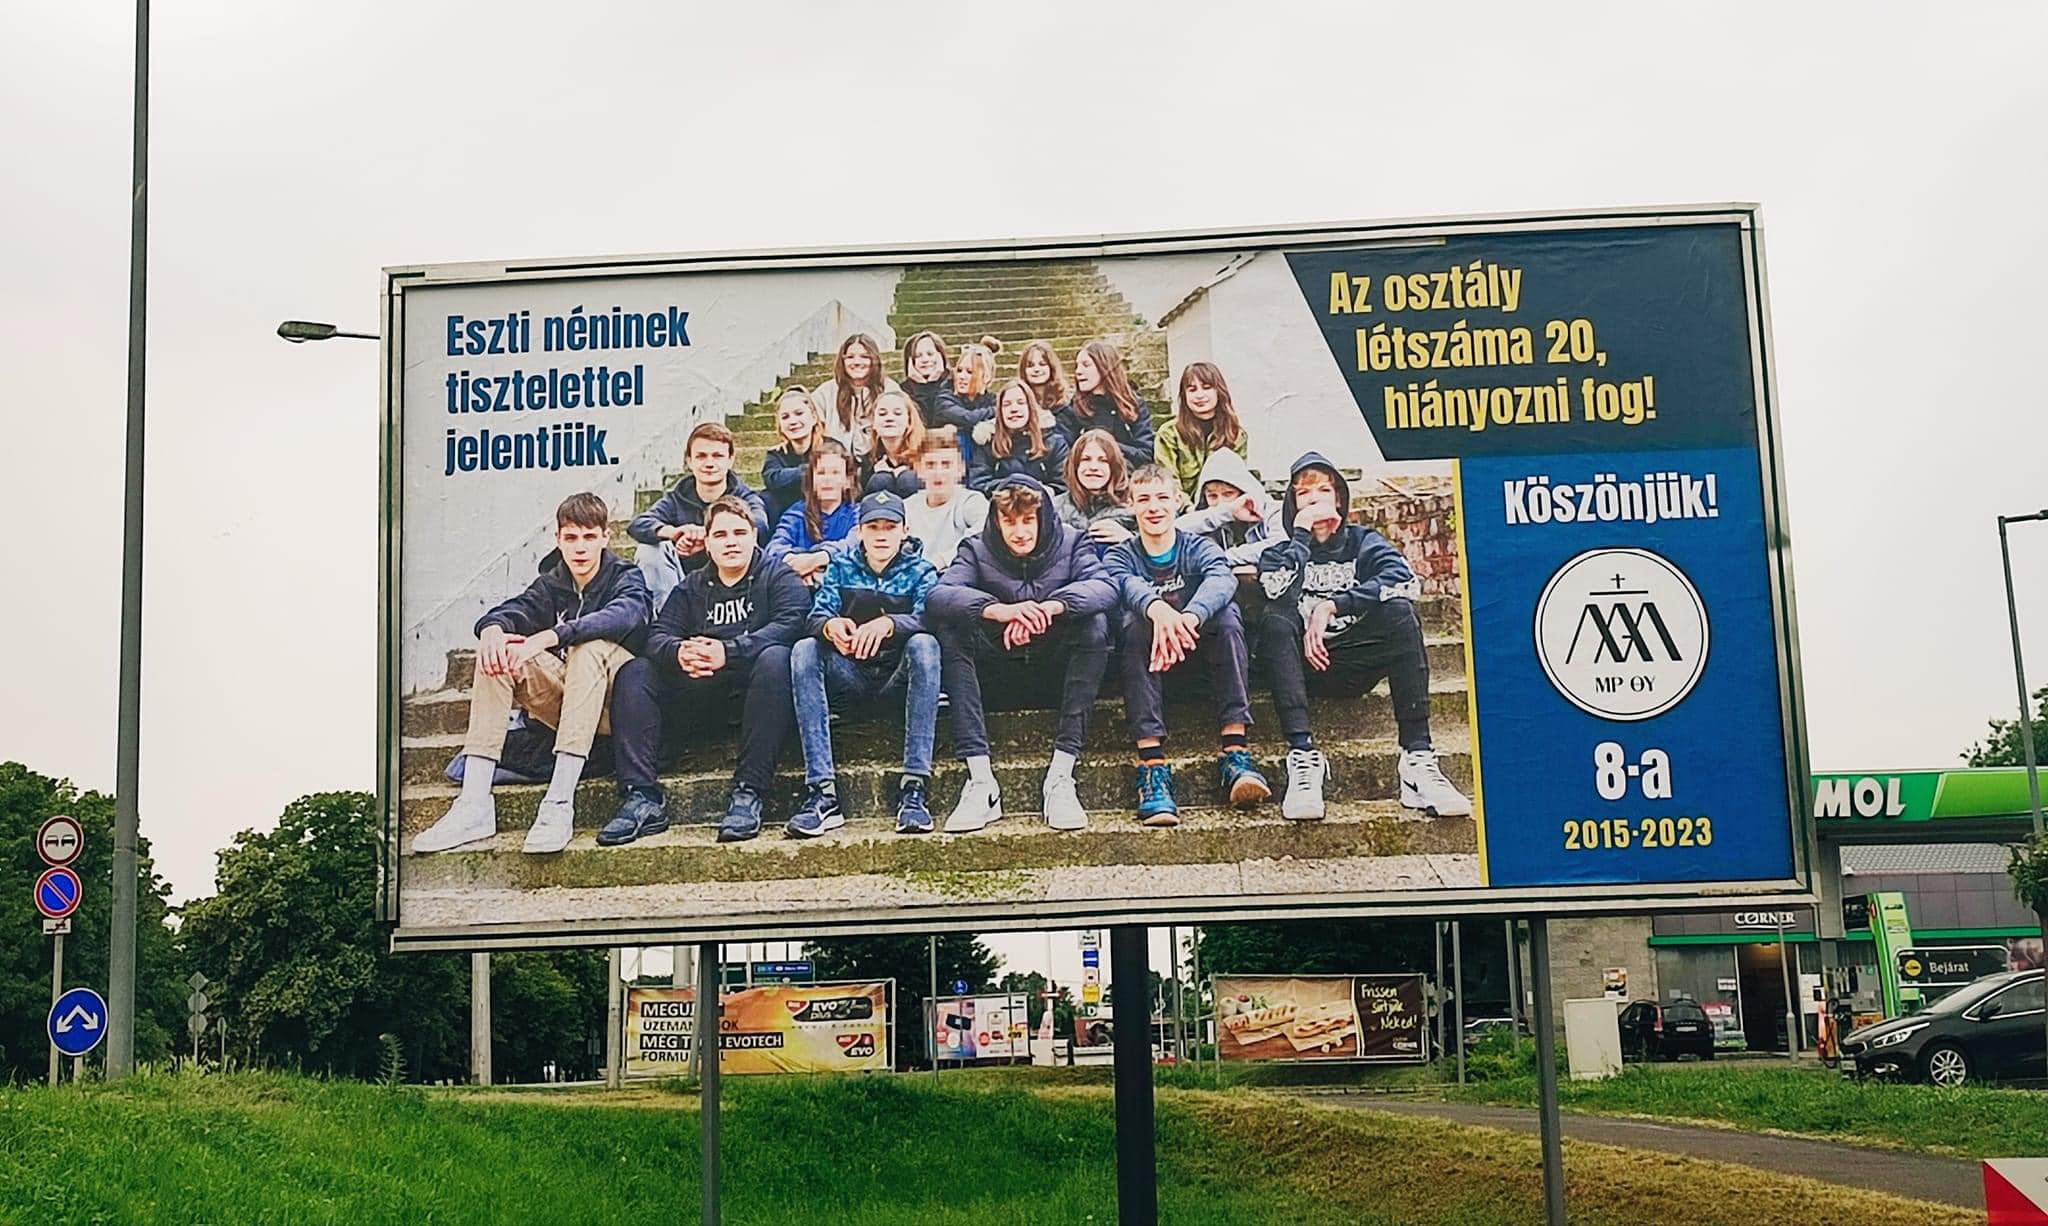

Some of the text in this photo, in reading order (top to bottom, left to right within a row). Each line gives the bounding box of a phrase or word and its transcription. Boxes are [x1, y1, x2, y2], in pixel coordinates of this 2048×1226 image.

[1329, 259, 1522, 315] Az osztály
[446, 305, 691, 356] Eszti néninek
[1356, 319, 1607, 372] létszáma 20,
[445, 365, 644, 414] tisztelettel
[1384, 376, 1657, 432] hiányozni fog!
[445, 422, 620, 476] jelentjük.
[1504, 472, 1719, 525] Köszönjük!
[1594, 742, 1672, 800] 8-a
[1813, 777, 1906, 817] MOL
[1361, 984, 1397, 998] Frissen
[1929, 961, 1969, 975] Bejárat
[812, 1001, 838, 1012] EVO
[642, 1033, 678, 1049] MÉG
[727, 1035, 782, 1048] EVOTECH
[851, 1047, 873, 1056] EVO
